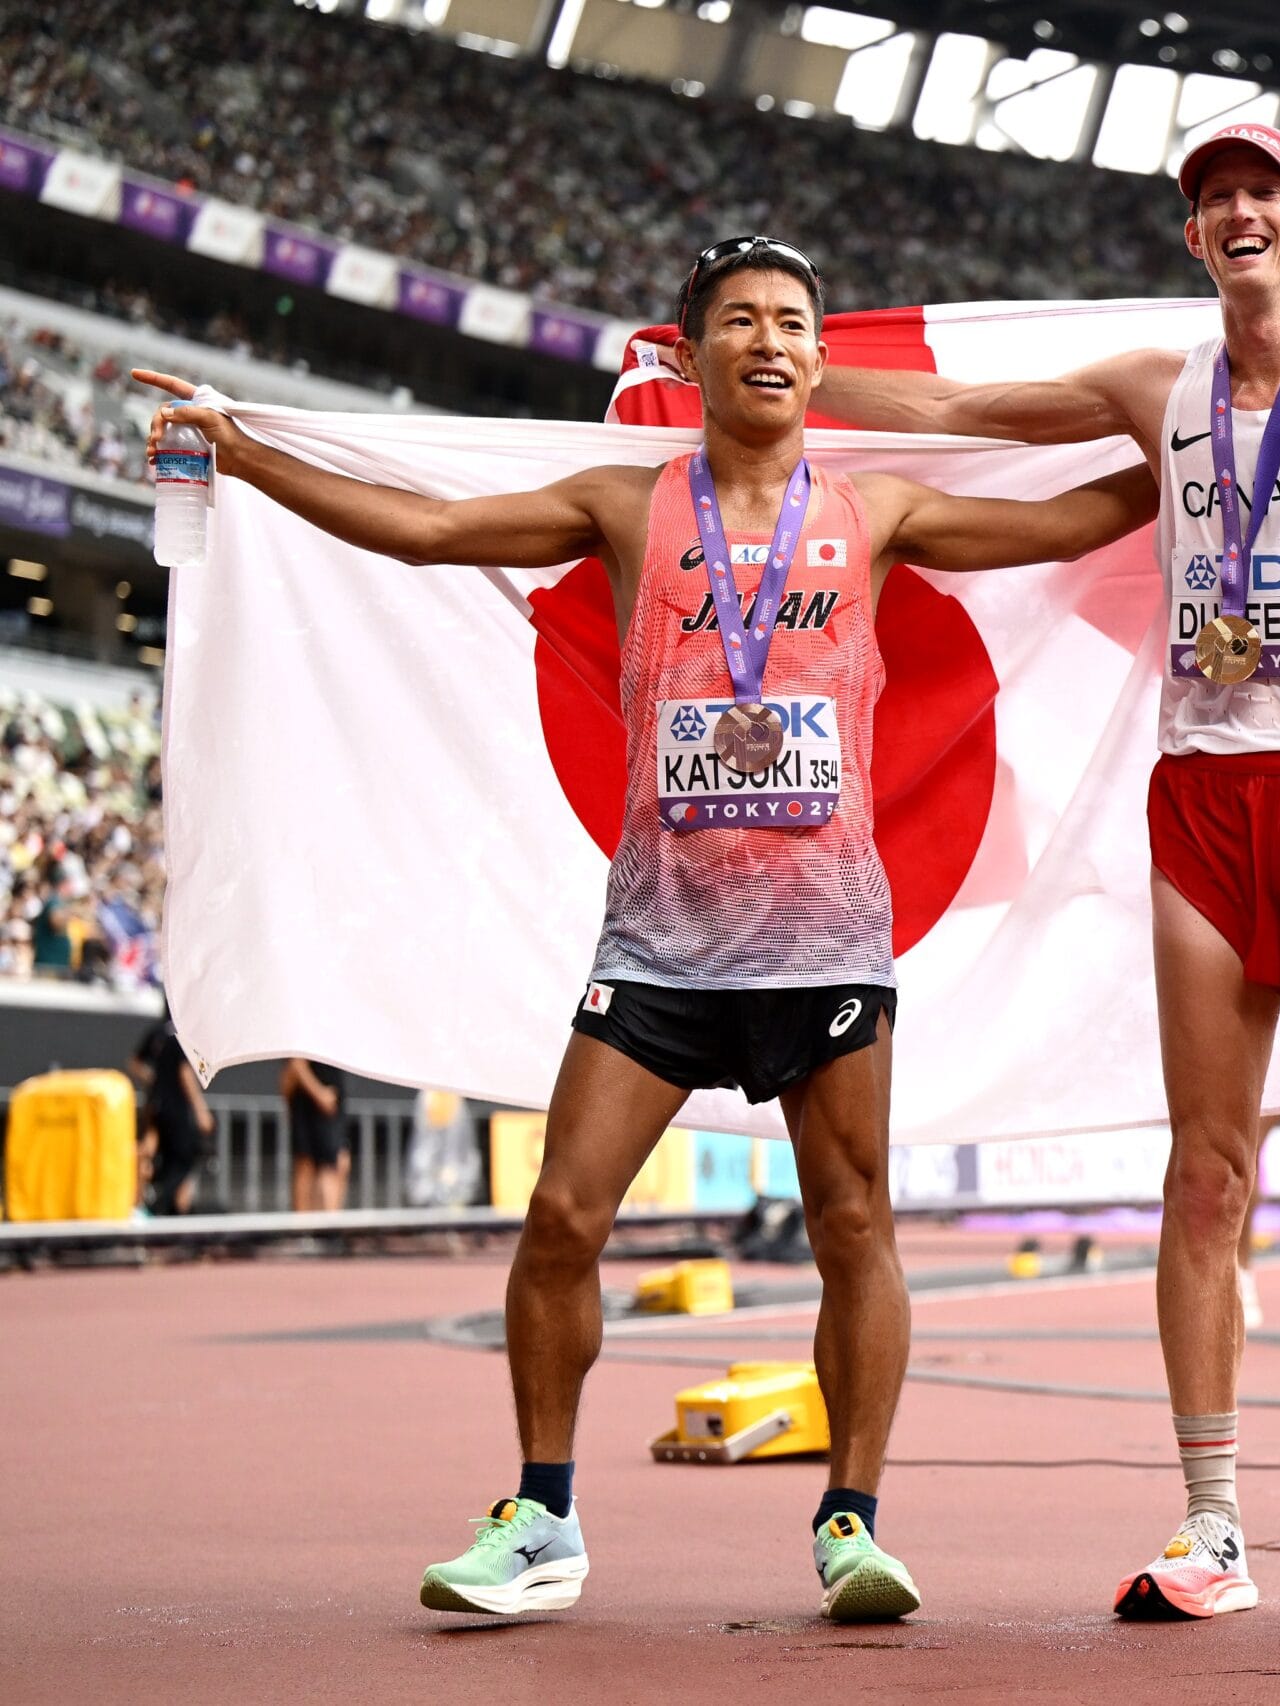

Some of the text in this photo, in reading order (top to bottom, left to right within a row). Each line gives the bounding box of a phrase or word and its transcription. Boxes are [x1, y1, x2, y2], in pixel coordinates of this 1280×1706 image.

[1220, 128, 1280, 150] ADA
[682, 591, 840, 632] JAN
[809, 759, 839, 789] 354
